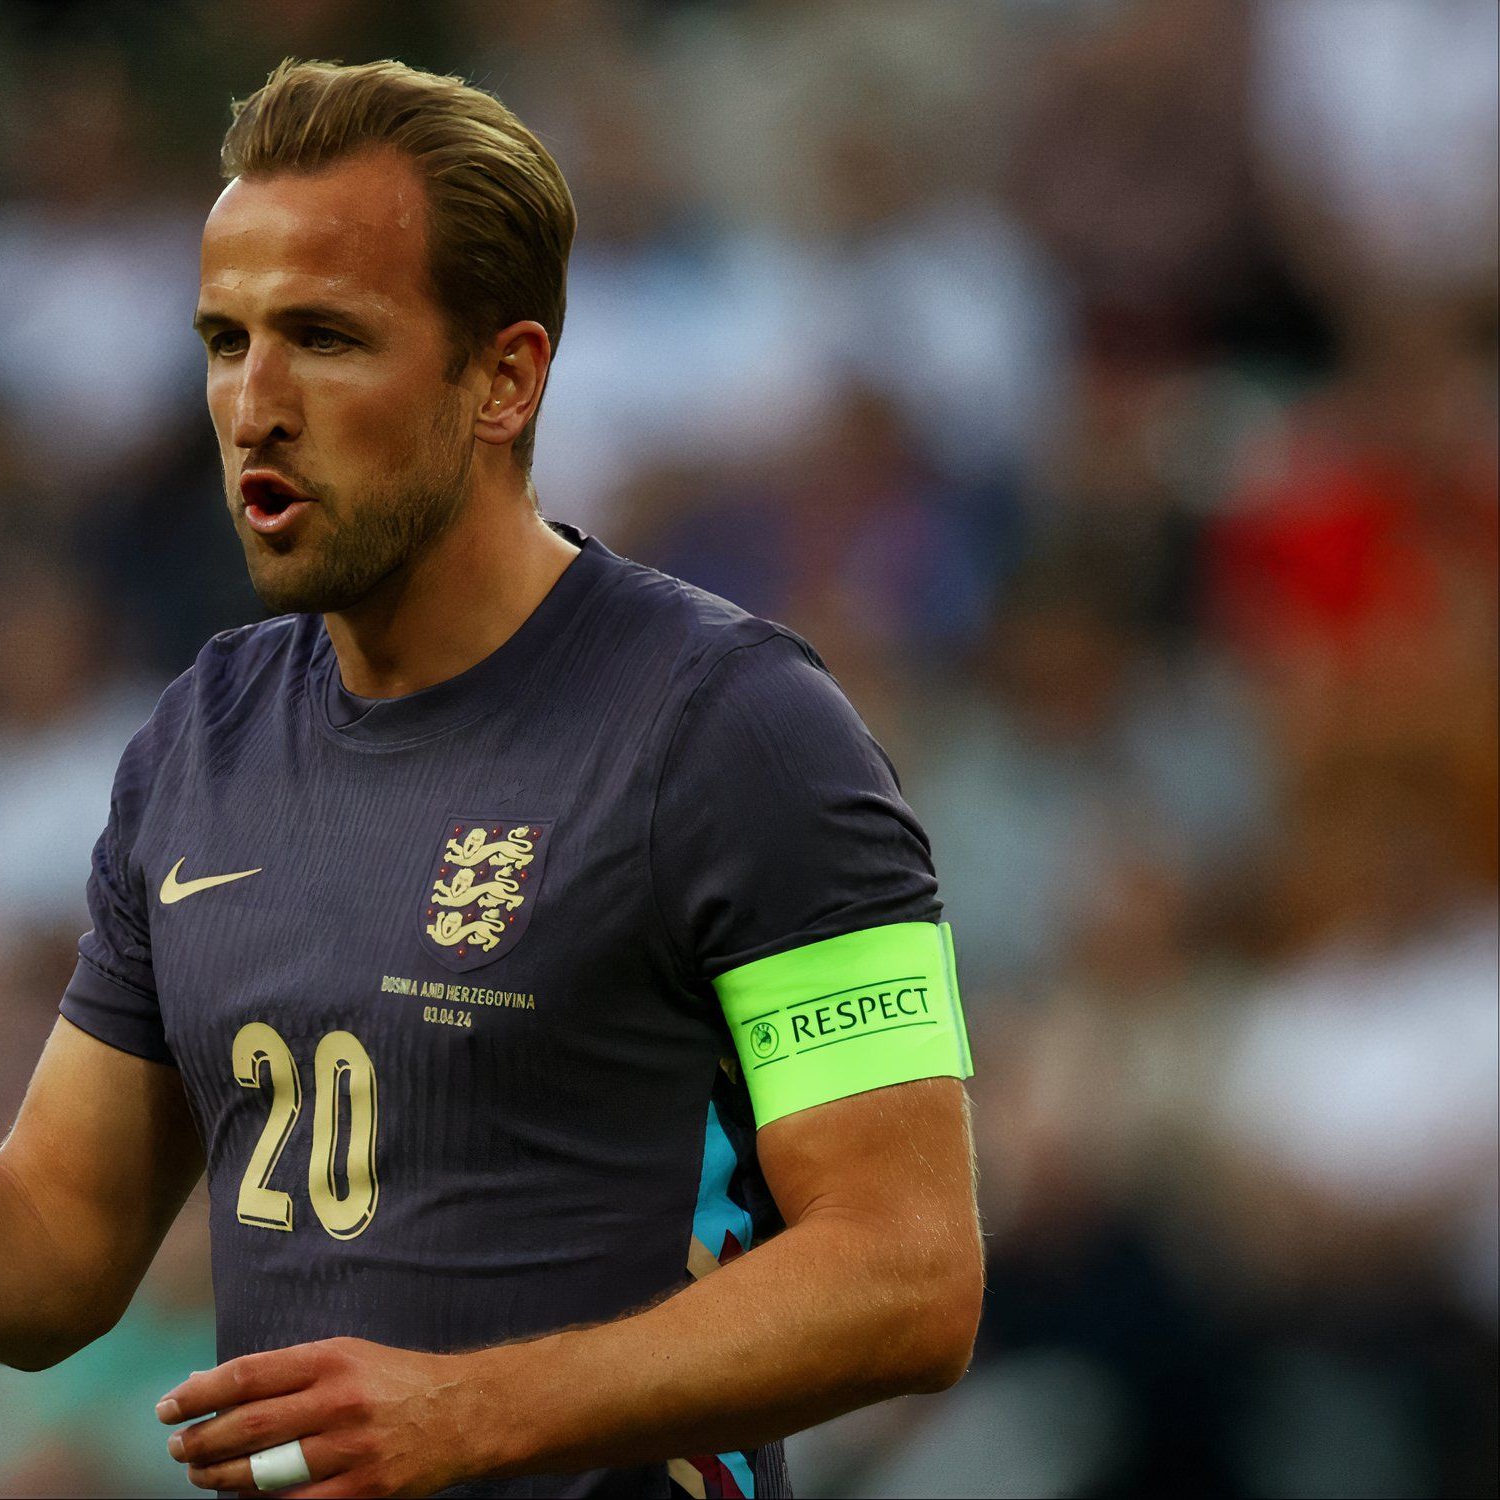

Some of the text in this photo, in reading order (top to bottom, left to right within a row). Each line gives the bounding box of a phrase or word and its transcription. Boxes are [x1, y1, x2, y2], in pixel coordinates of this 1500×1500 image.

[381, 975, 535, 1010] BOSNIA AND HERZEGOVINA
[791, 987, 929, 1043] RESPECT
[232, 1021, 379, 1241] 20
